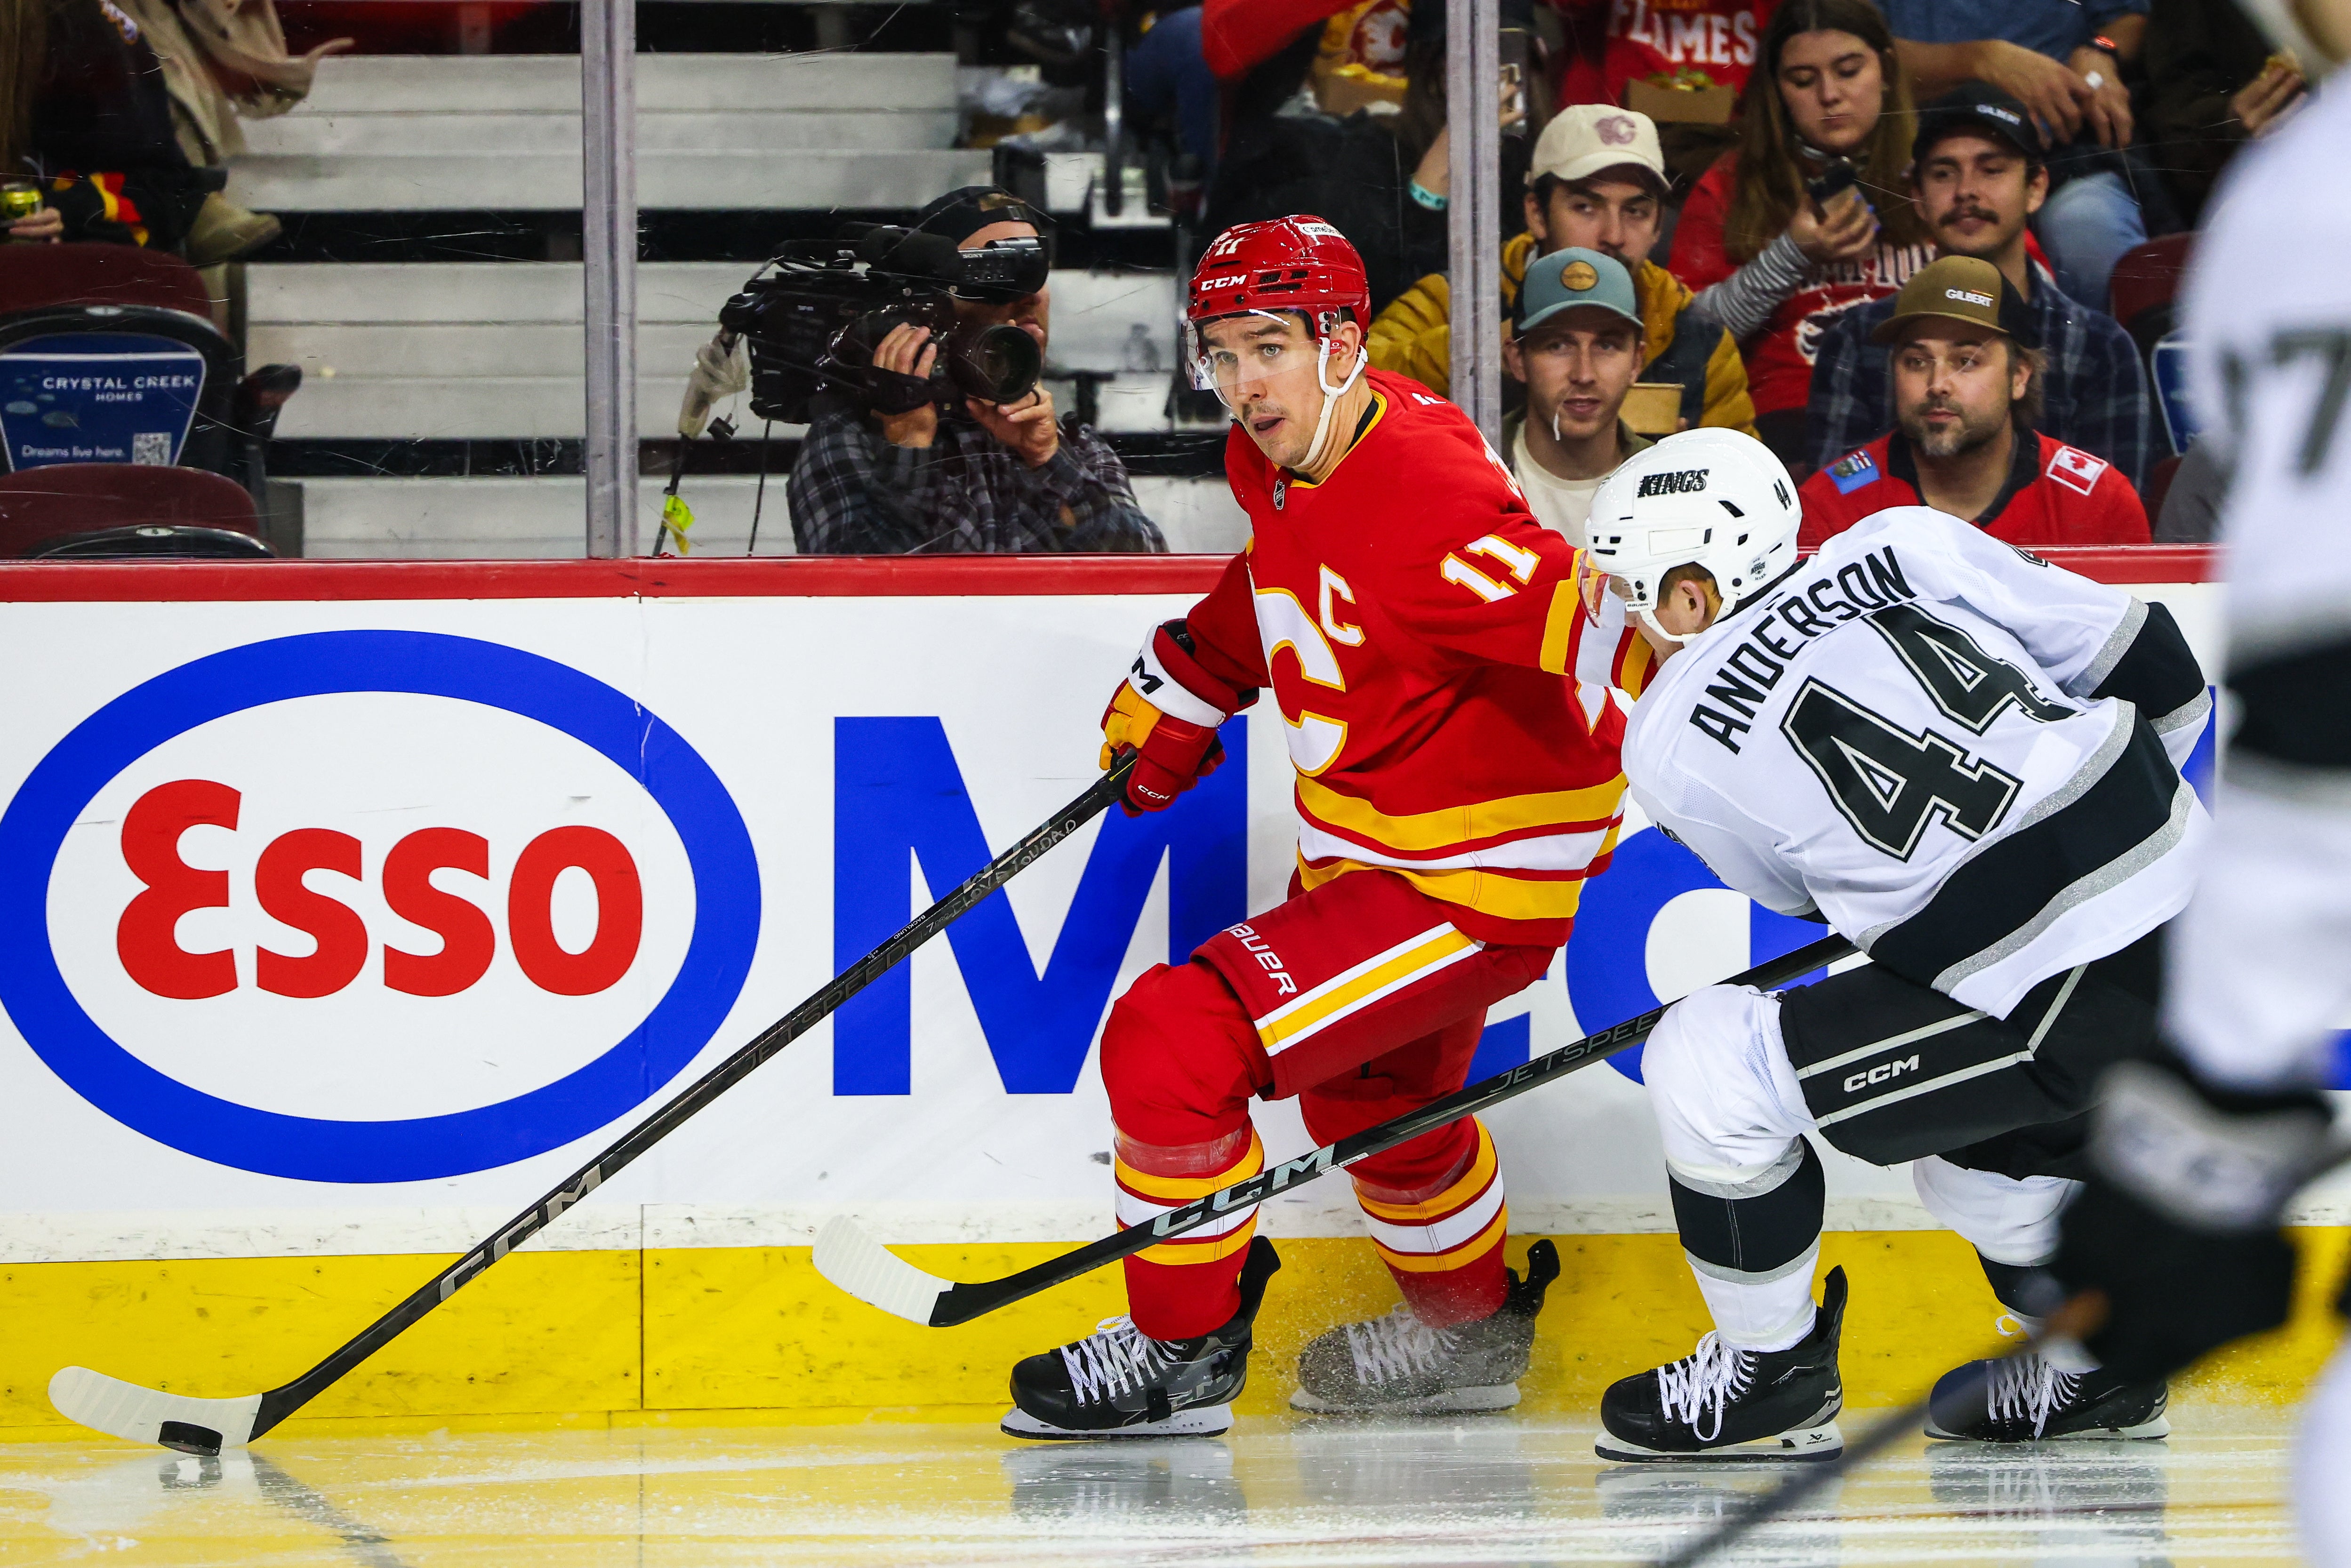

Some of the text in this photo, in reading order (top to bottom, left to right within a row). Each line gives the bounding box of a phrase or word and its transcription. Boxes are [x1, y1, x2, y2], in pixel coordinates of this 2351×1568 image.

[1201, 274, 1247, 291] CCM
[1945, 288, 1993, 307] GILBERT
[43, 375, 196, 390] CRYSTAL CREEK
[96, 392, 143, 402] HOMES
[22, 444, 69, 458] Dreams
[1637, 469, 1709, 498] KINGS
[1440, 534, 1541, 604] 11
[1319, 563, 1365, 647] C
[1689, 545, 1917, 755] ANDERSON
[1780, 602, 2085, 863] 44
[1138, 784, 1171, 800] CCM
[1038, 819, 1077, 851] DAD
[893, 914, 926, 940] BACKLUND
[734, 944, 907, 1074] JETSPEED
[1844, 1054, 1920, 1093] CCM
[1152, 1143, 1335, 1237] CCM
[440, 1164, 602, 1302] CCM
